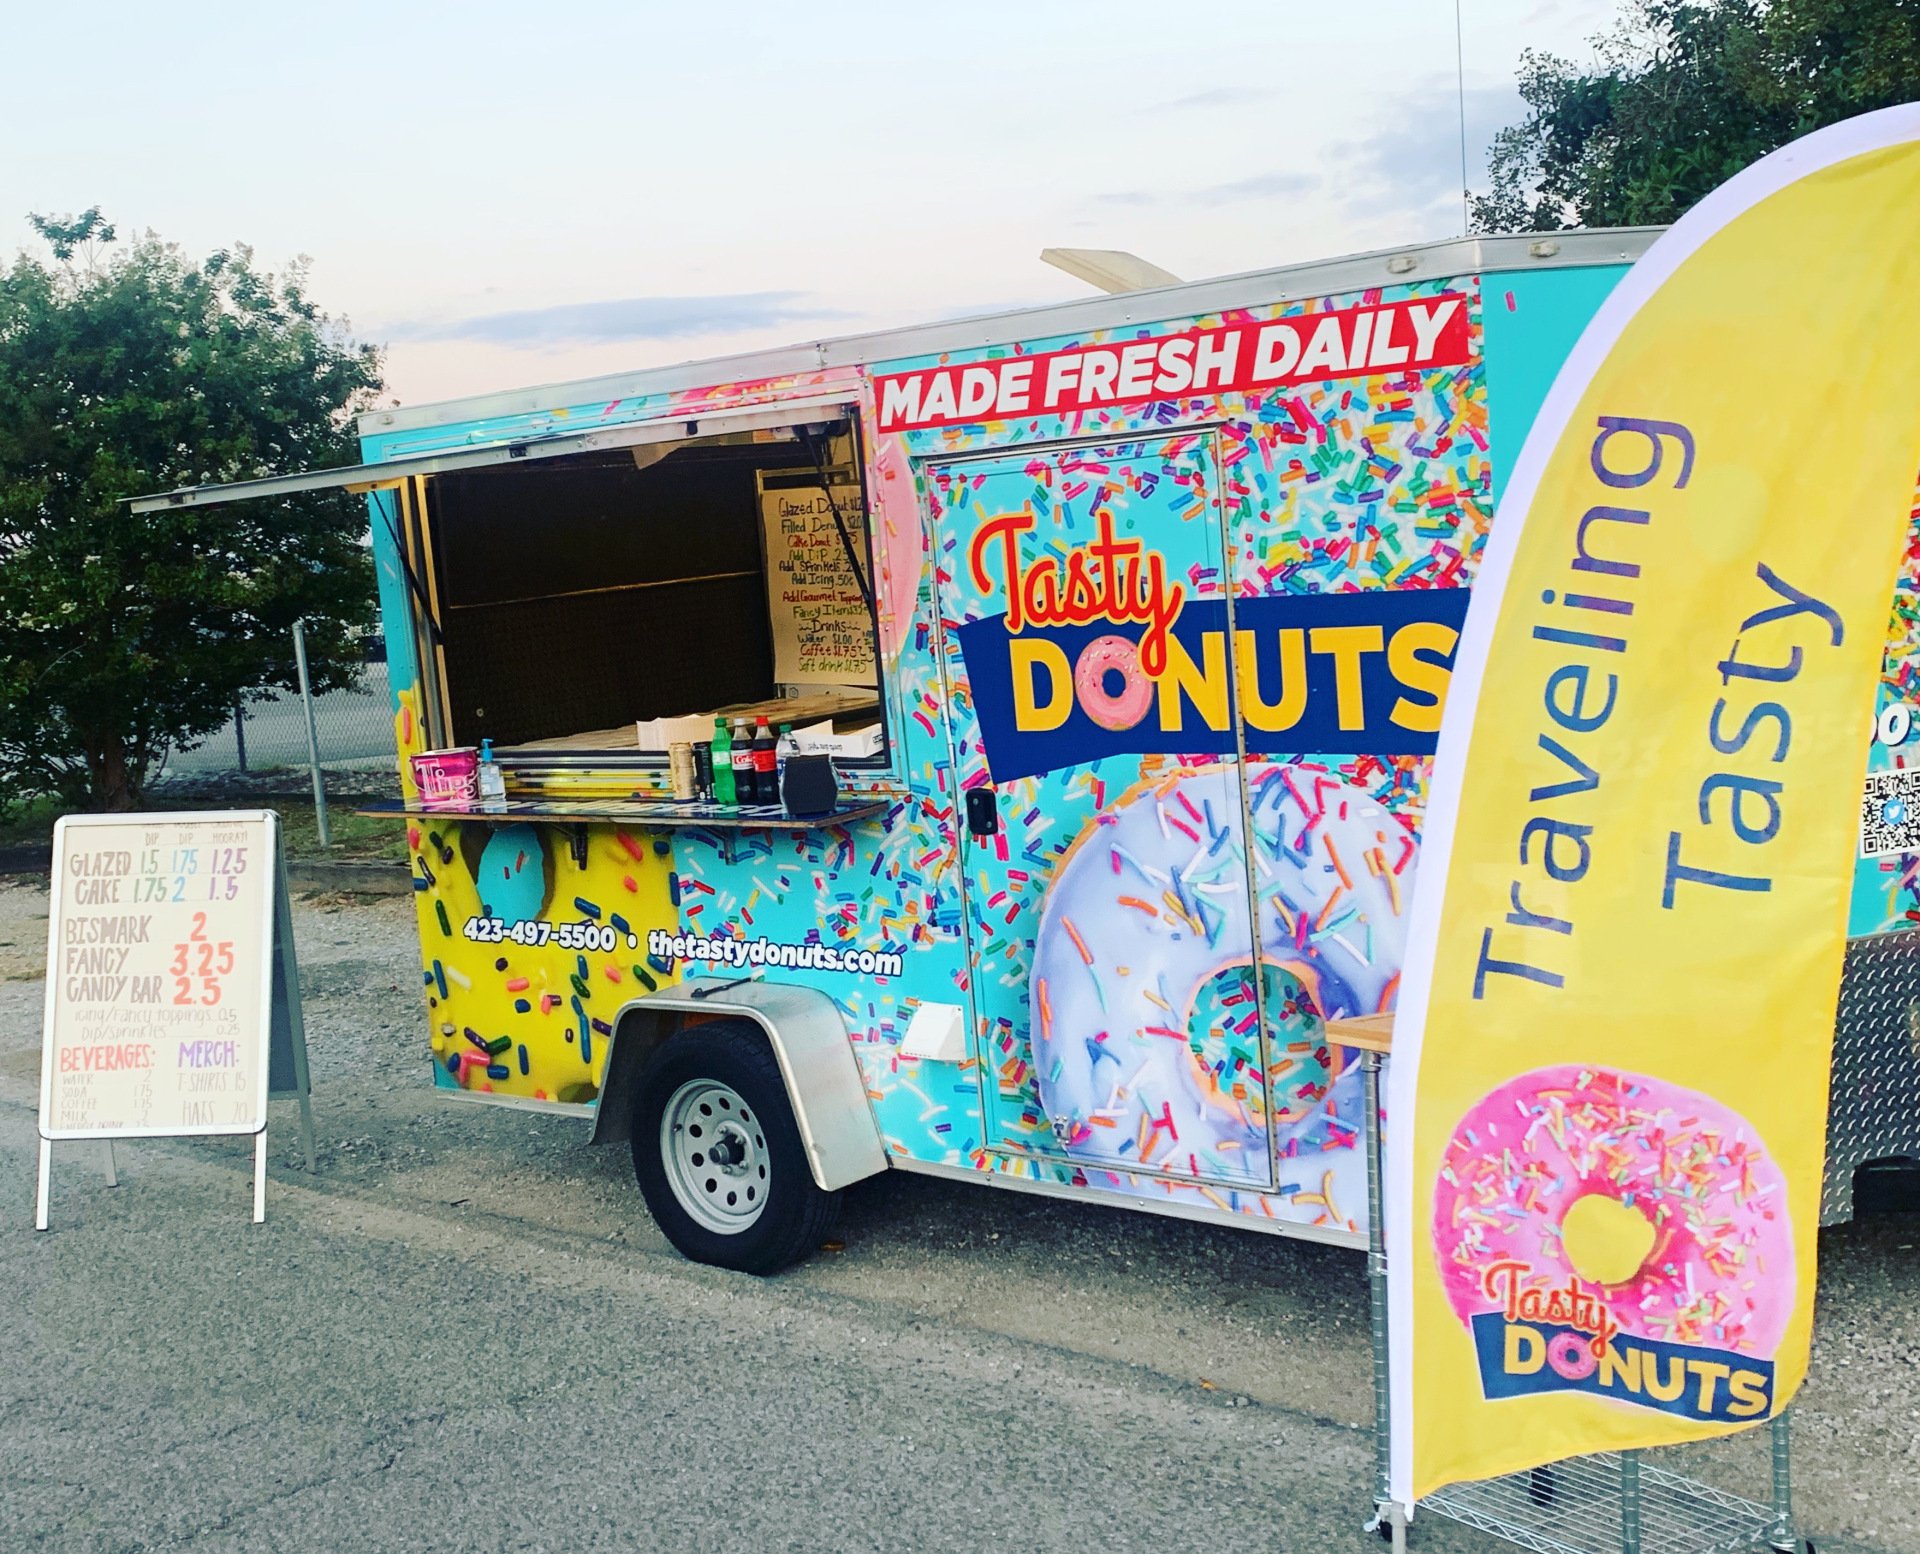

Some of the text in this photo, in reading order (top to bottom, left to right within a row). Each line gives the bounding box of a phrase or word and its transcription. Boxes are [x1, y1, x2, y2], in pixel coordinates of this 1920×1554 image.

[880, 299, 1462, 426] MADE FRESH DAILY
[778, 497, 814, 517] Glazed
[781, 518, 806, 534] Filled
[812, 517, 837, 532] Donu
[808, 573, 834, 589] Icing
[968, 508, 1187, 677] Tasty
[793, 605, 820, 620] Fancy
[797, 633, 827, 643] Water
[800, 644, 831, 656] Coffee
[1008, 622, 1460, 733] DONUTS
[1472, 416, 1696, 1000] Traveling
[1662, 561, 1844, 909] Tasty
[70, 851, 132, 877] GLAZED
[141, 849, 160, 875] 1.5
[211, 848, 248, 875] 1.25
[75, 876, 239, 905] CAKE 1.75 2 1.5
[66, 911, 207, 944] BISMARK 2
[66, 941, 234, 977] FANCY 3.25
[463, 917, 904, 976] 423-497-5500 thetastydonuts.com
[66, 975, 222, 1006] CANDY BAR 2.5
[60, 1040, 241, 1072] BEVERAGES: MERCH:
[62, 1086, 87, 1098] SODA
[182, 1101, 248, 1126] HATS 20
[1482, 1259, 1617, 1358] Tasty
[1503, 1324, 1769, 1417] DONUTS
